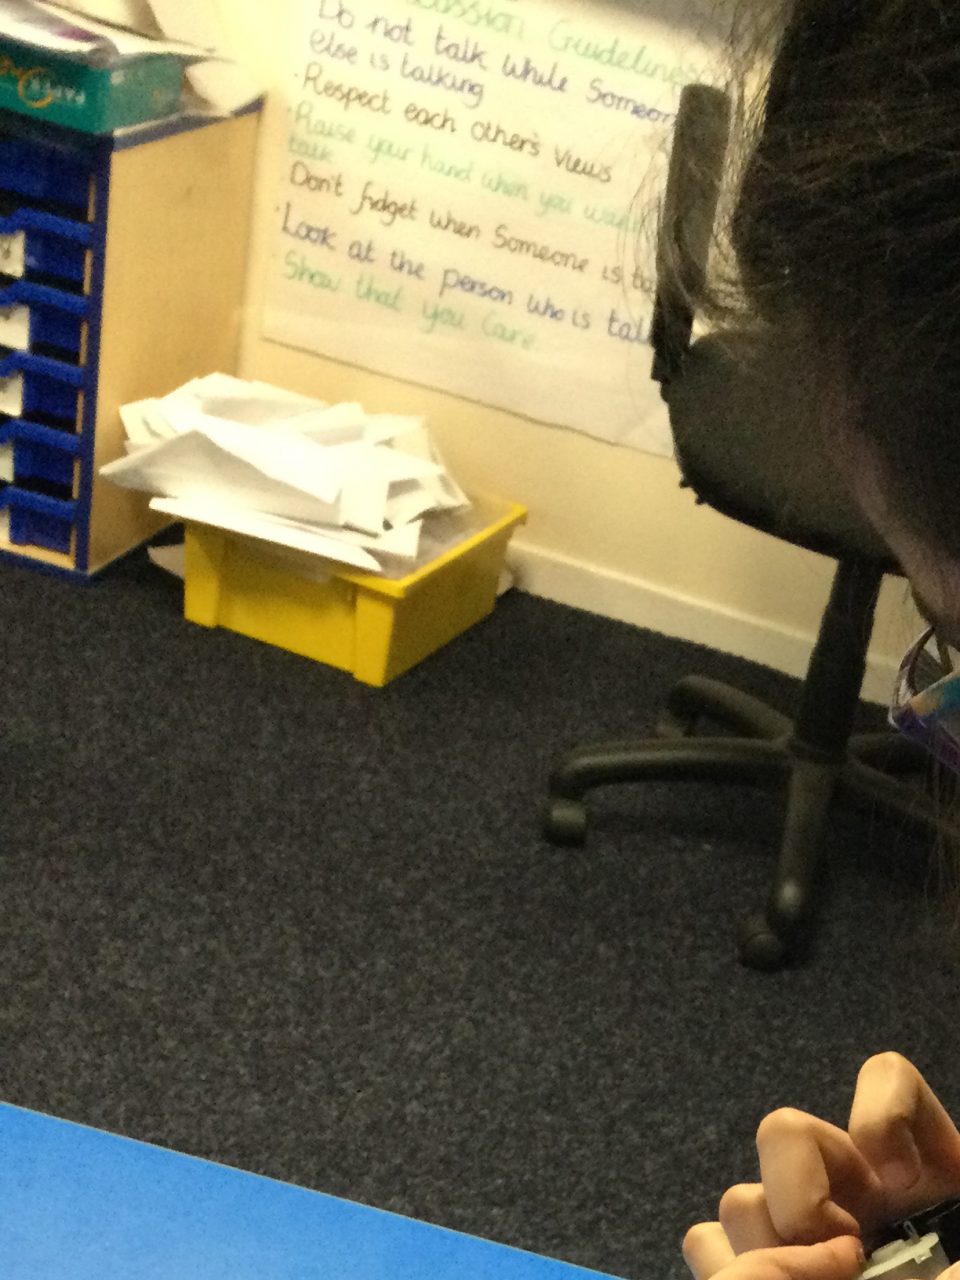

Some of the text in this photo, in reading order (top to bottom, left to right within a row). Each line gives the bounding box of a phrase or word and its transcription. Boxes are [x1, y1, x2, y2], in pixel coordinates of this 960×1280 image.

[318, 0, 677, 126] Do not talk while Someon
[407, 0, 525, 40] ussion
[303, 61, 390, 114] Respect
[404, 102, 456, 132] each
[309, 29, 484, 109] else is talking
[295, 99, 357, 143] Raise
[368, 134, 412, 166] your
[421, 143, 474, 182] hand
[481, 168, 528, 200] when
[536, 191, 573, 218] you
[281, 201, 337, 251] Look
[348, 239, 375, 263] at
[390, 249, 426, 281] the
[437, 268, 513, 306] person
[527, 294, 565, 322] who
[571, 308, 591, 331] is
[350, 180, 417, 227] fidget
[429, 209, 480, 239] when
[492, 223, 590, 273] Someone
[602, 264, 622, 285] is
[283, 250, 341, 292] Show
[356, 272, 404, 312] that
[420, 299, 464, 335] you
